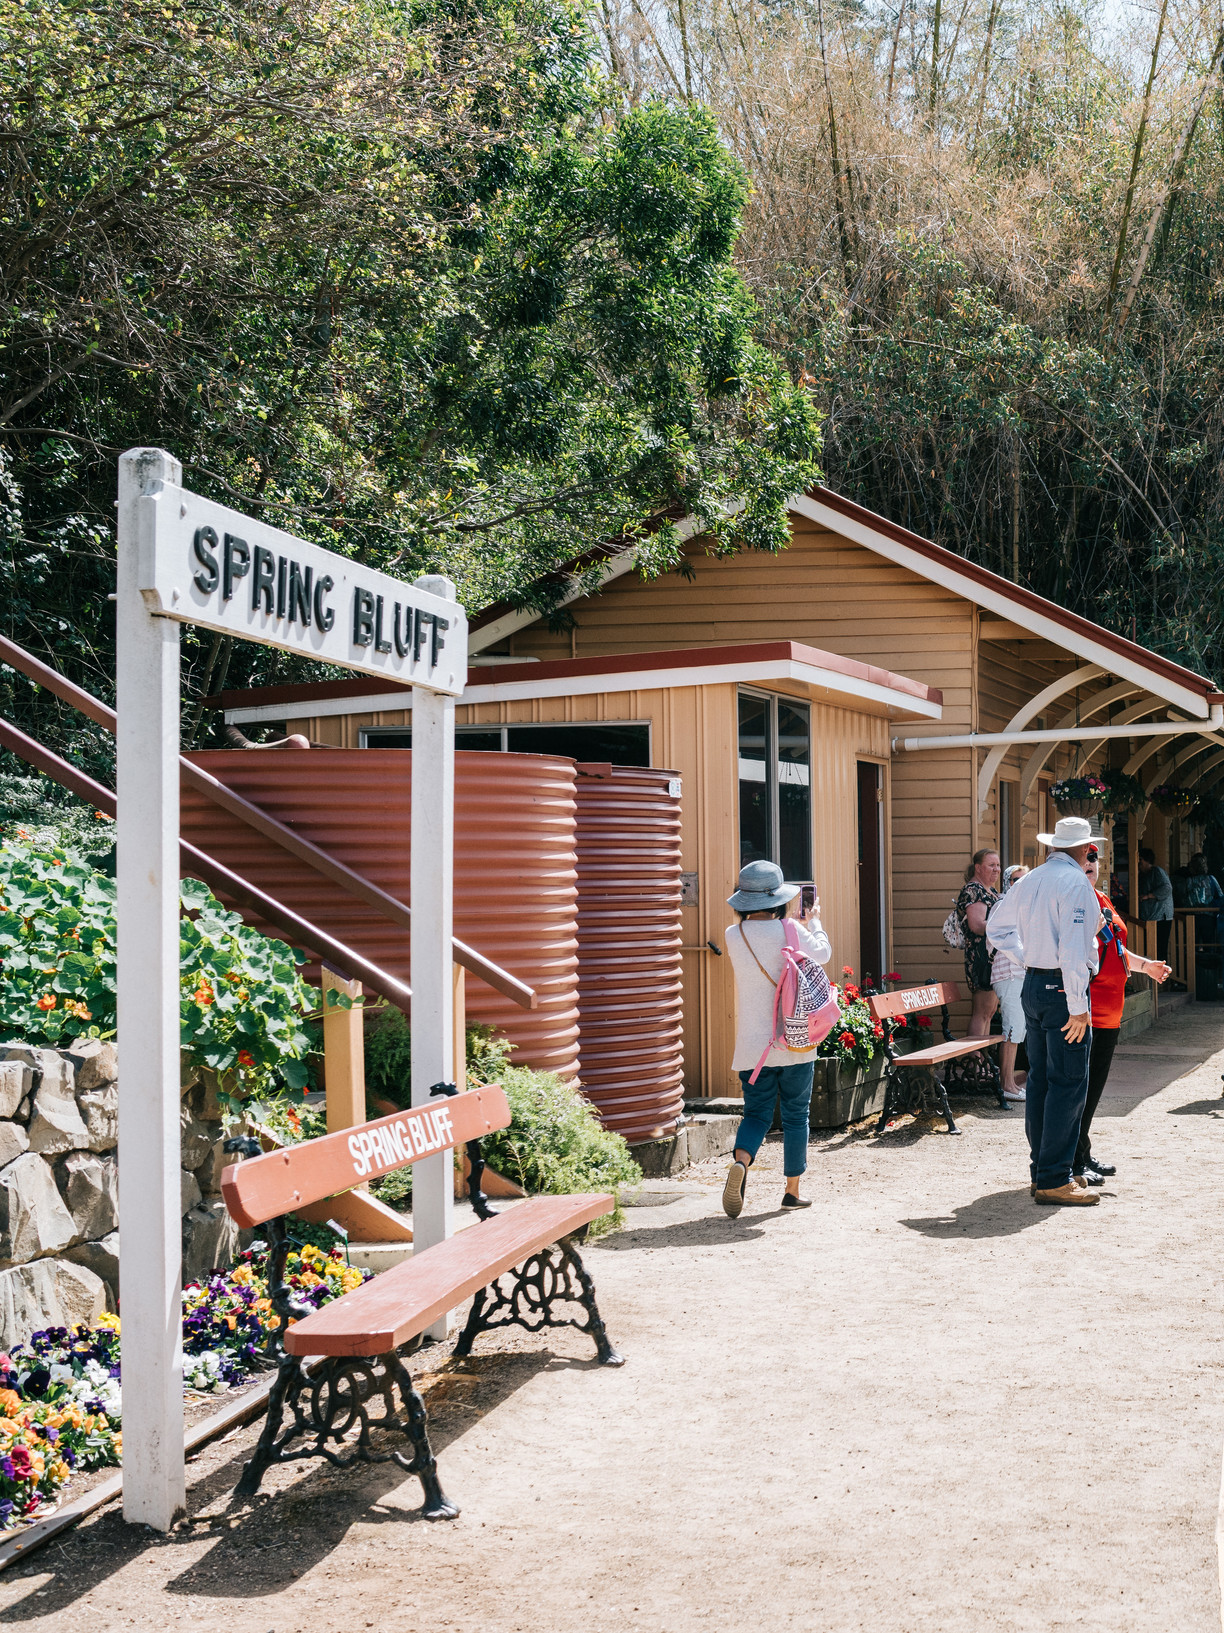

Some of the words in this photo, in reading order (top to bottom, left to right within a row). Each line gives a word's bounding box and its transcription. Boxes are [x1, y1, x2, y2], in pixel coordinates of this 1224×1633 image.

[193, 525, 335, 633] SPRING
[353, 586, 449, 668] BLUFF
[347, 1120, 415, 1176] SPRING
[407, 1106, 454, 1155] BLUFF
